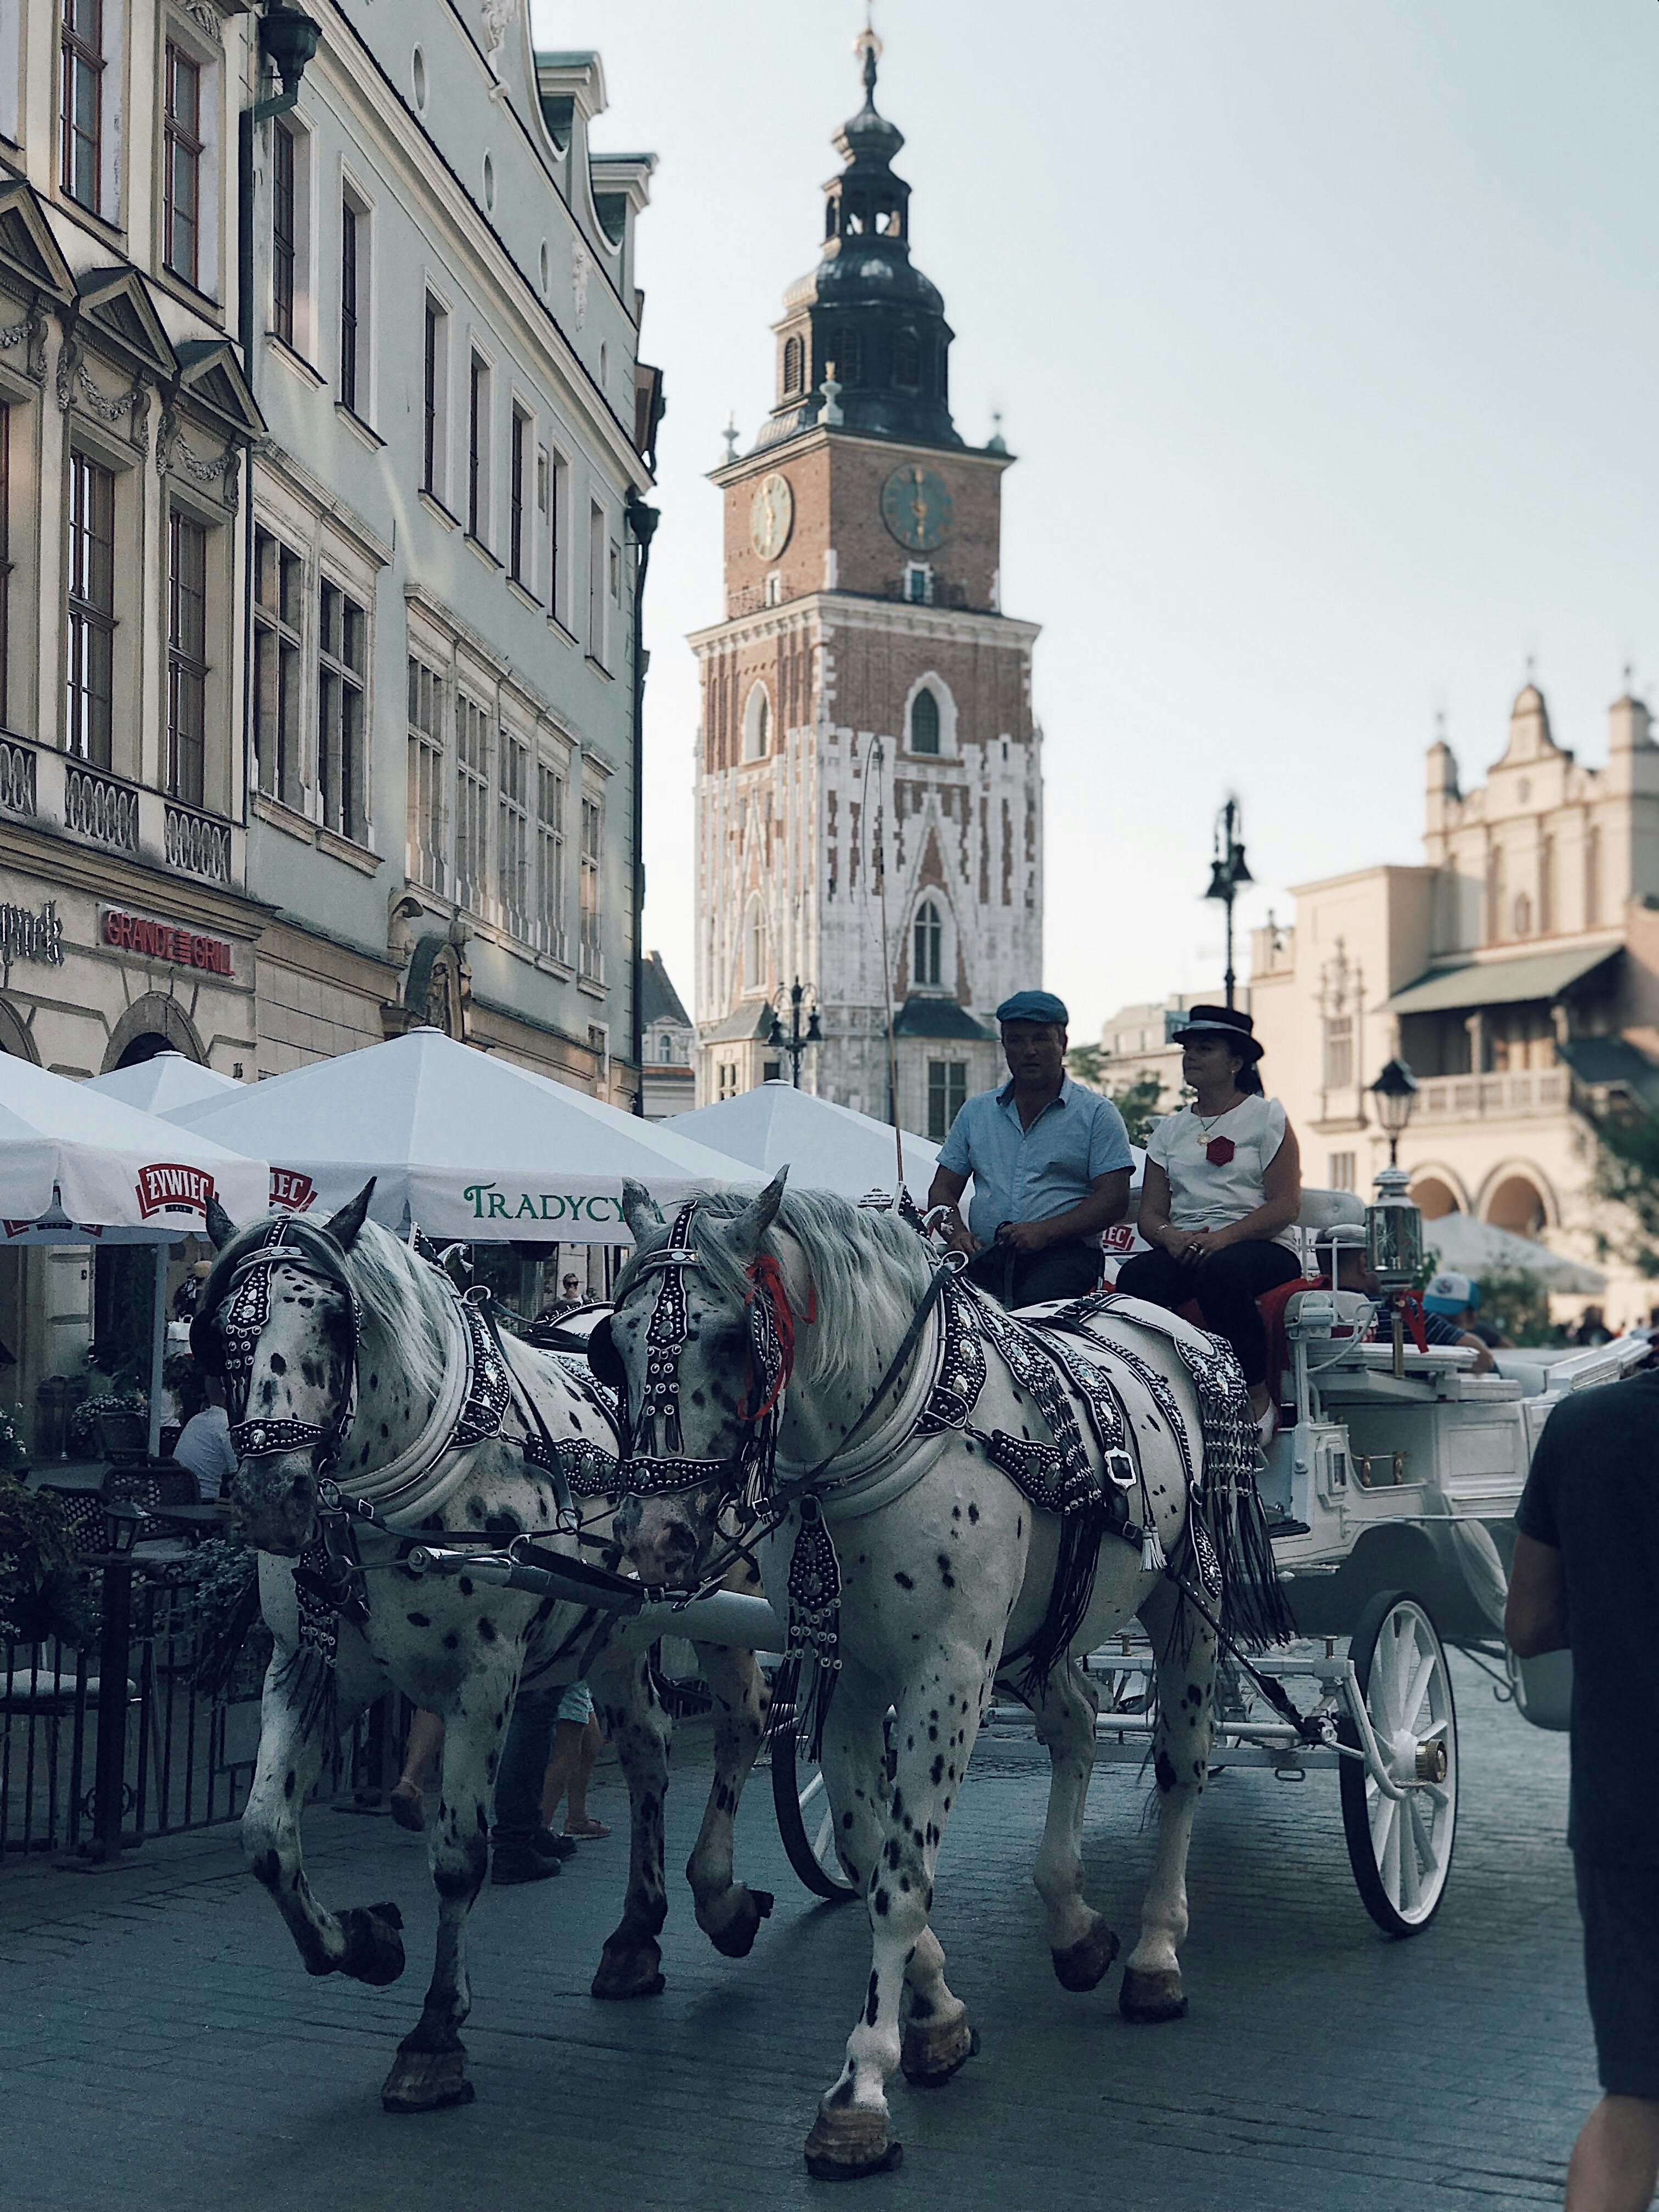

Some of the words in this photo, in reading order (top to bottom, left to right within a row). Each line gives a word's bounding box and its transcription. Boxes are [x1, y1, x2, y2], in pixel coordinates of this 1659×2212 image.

[106, 910, 176, 961] GRANDE
[195, 935, 236, 975] GRILL
[145, 1168, 209, 1204] ŻYWIEC
[464, 1182, 667, 1224] TRADYCYA
